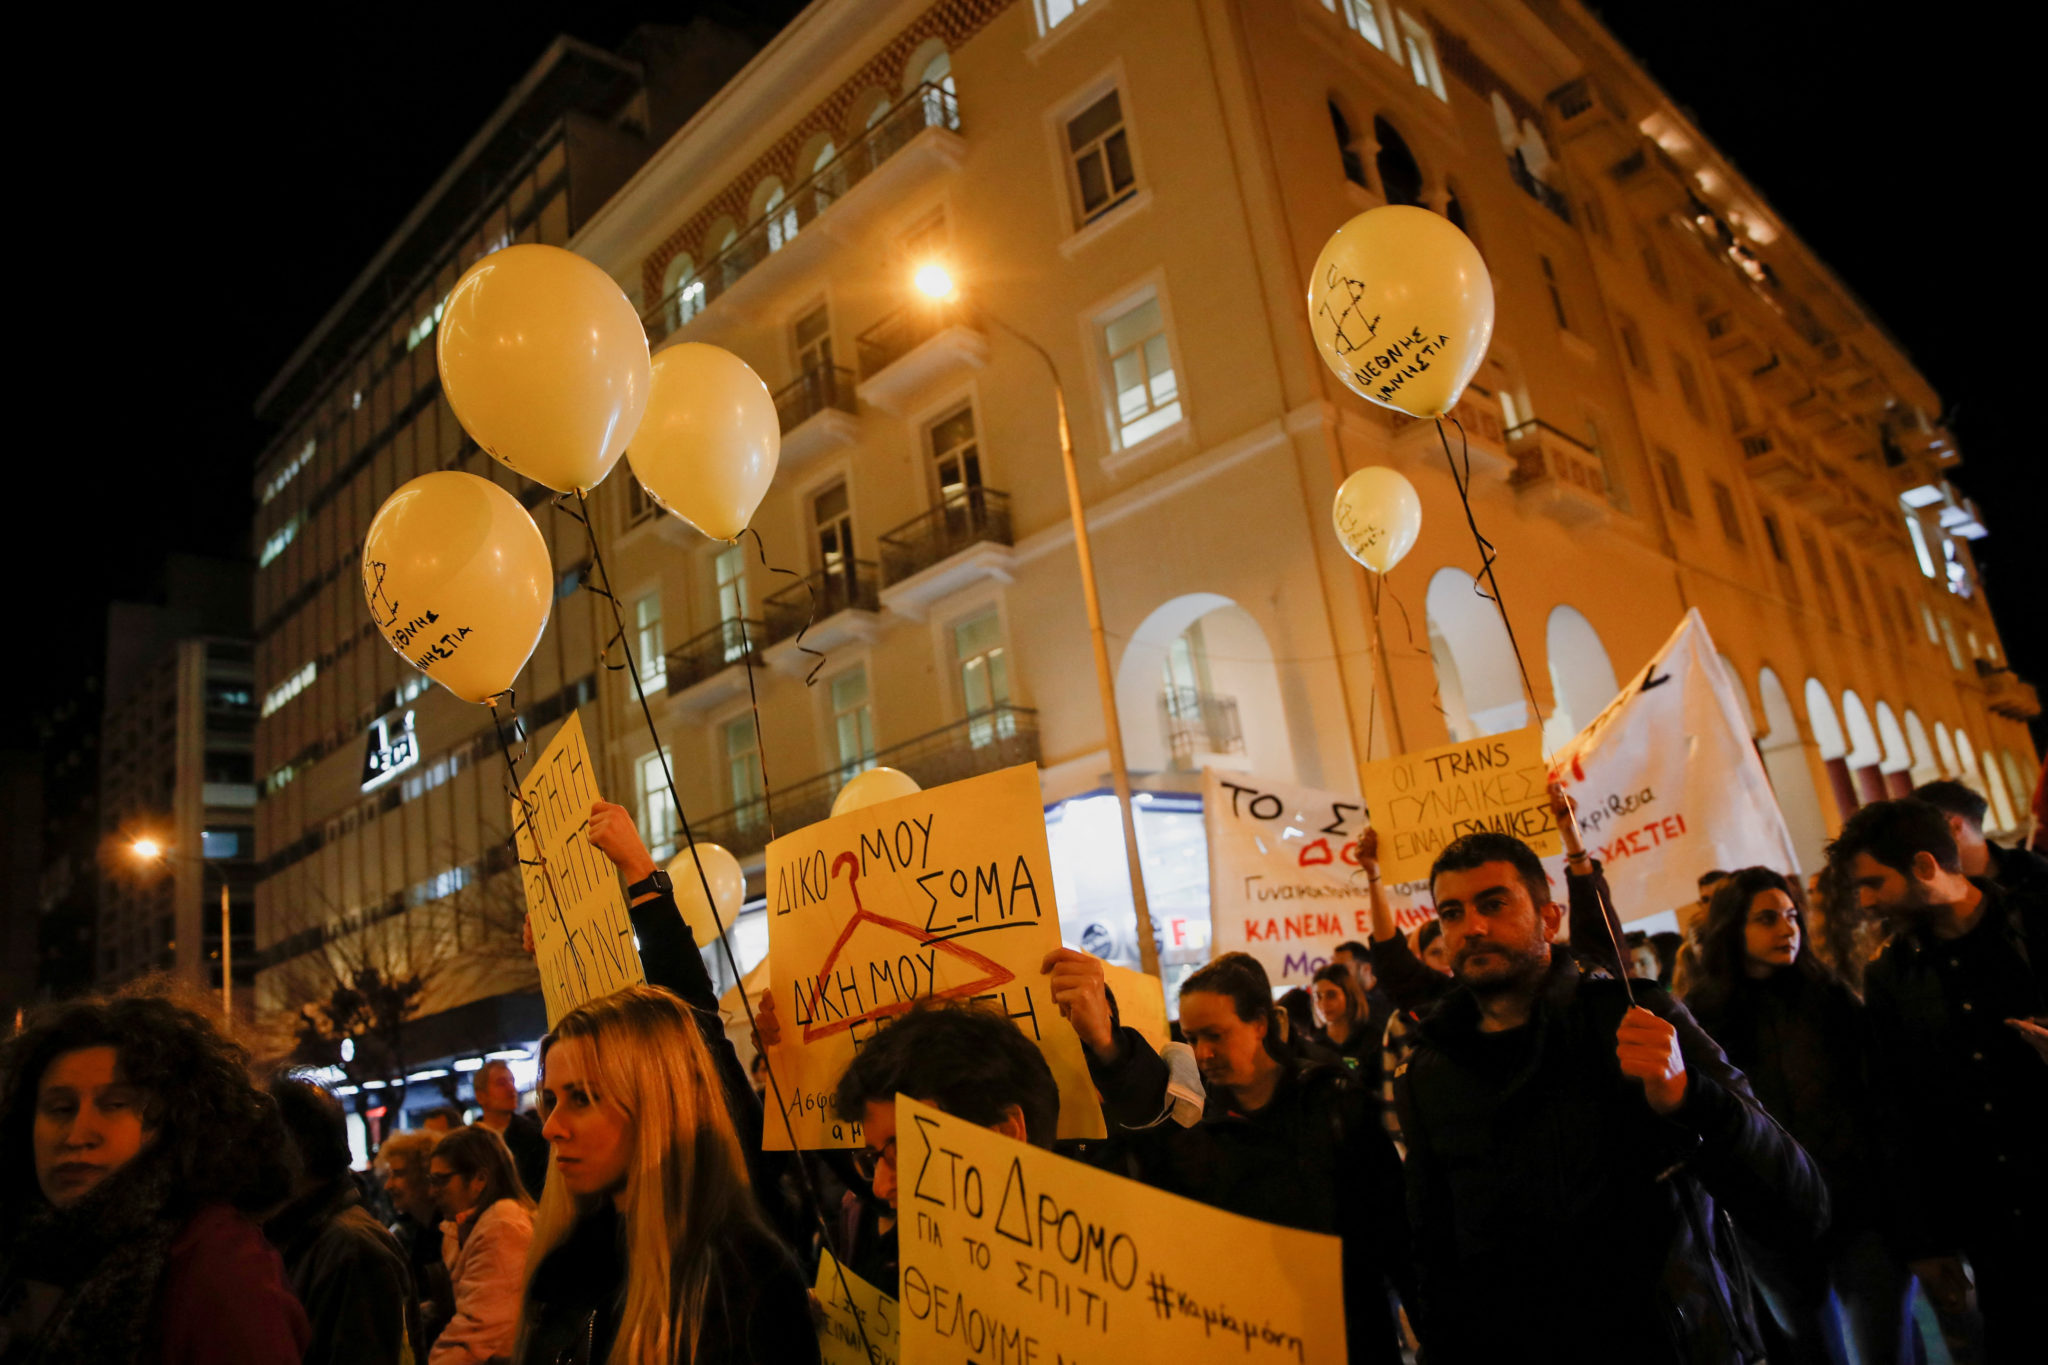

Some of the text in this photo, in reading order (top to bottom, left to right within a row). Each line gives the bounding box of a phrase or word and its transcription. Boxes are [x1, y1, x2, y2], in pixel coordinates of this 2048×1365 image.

[1354, 326, 1428, 386] ΔΙΕΘΝΗΣ
[1375, 334, 1450, 402] ΑΜΝΗΣΤΙΑ
[1388, 764, 1550, 830] ΓΥΝΑΙΚΕΣ
[1393, 764, 1416, 793] ΟΙ
[1424, 743, 1510, 782] TRANS
[1220, 780, 1370, 837] ΤΟ Σ
[1594, 813, 1686, 864] ΧΑΣΤΕΙ
[777, 813, 933, 917] ΔΙΚΟ ΜΟΥ
[1394, 827, 1447, 861] ΕΙΝΑΙ
[1244, 913, 1343, 943] ΚΑΝΕΝΑ
[794, 966, 864, 1026] ΔΙΚΗ
[869, 949, 935, 1005] ΜΟΥ
[914, 1114, 1138, 1291] ΣΤΟ ΔΡΟΜΟ
[917, 1211, 1108, 1334] ΓΙΑ ΤΟ ΣΠΙΤΙ
[904, 1265, 1040, 1365] ΘΕΛΟΥΜΕ
